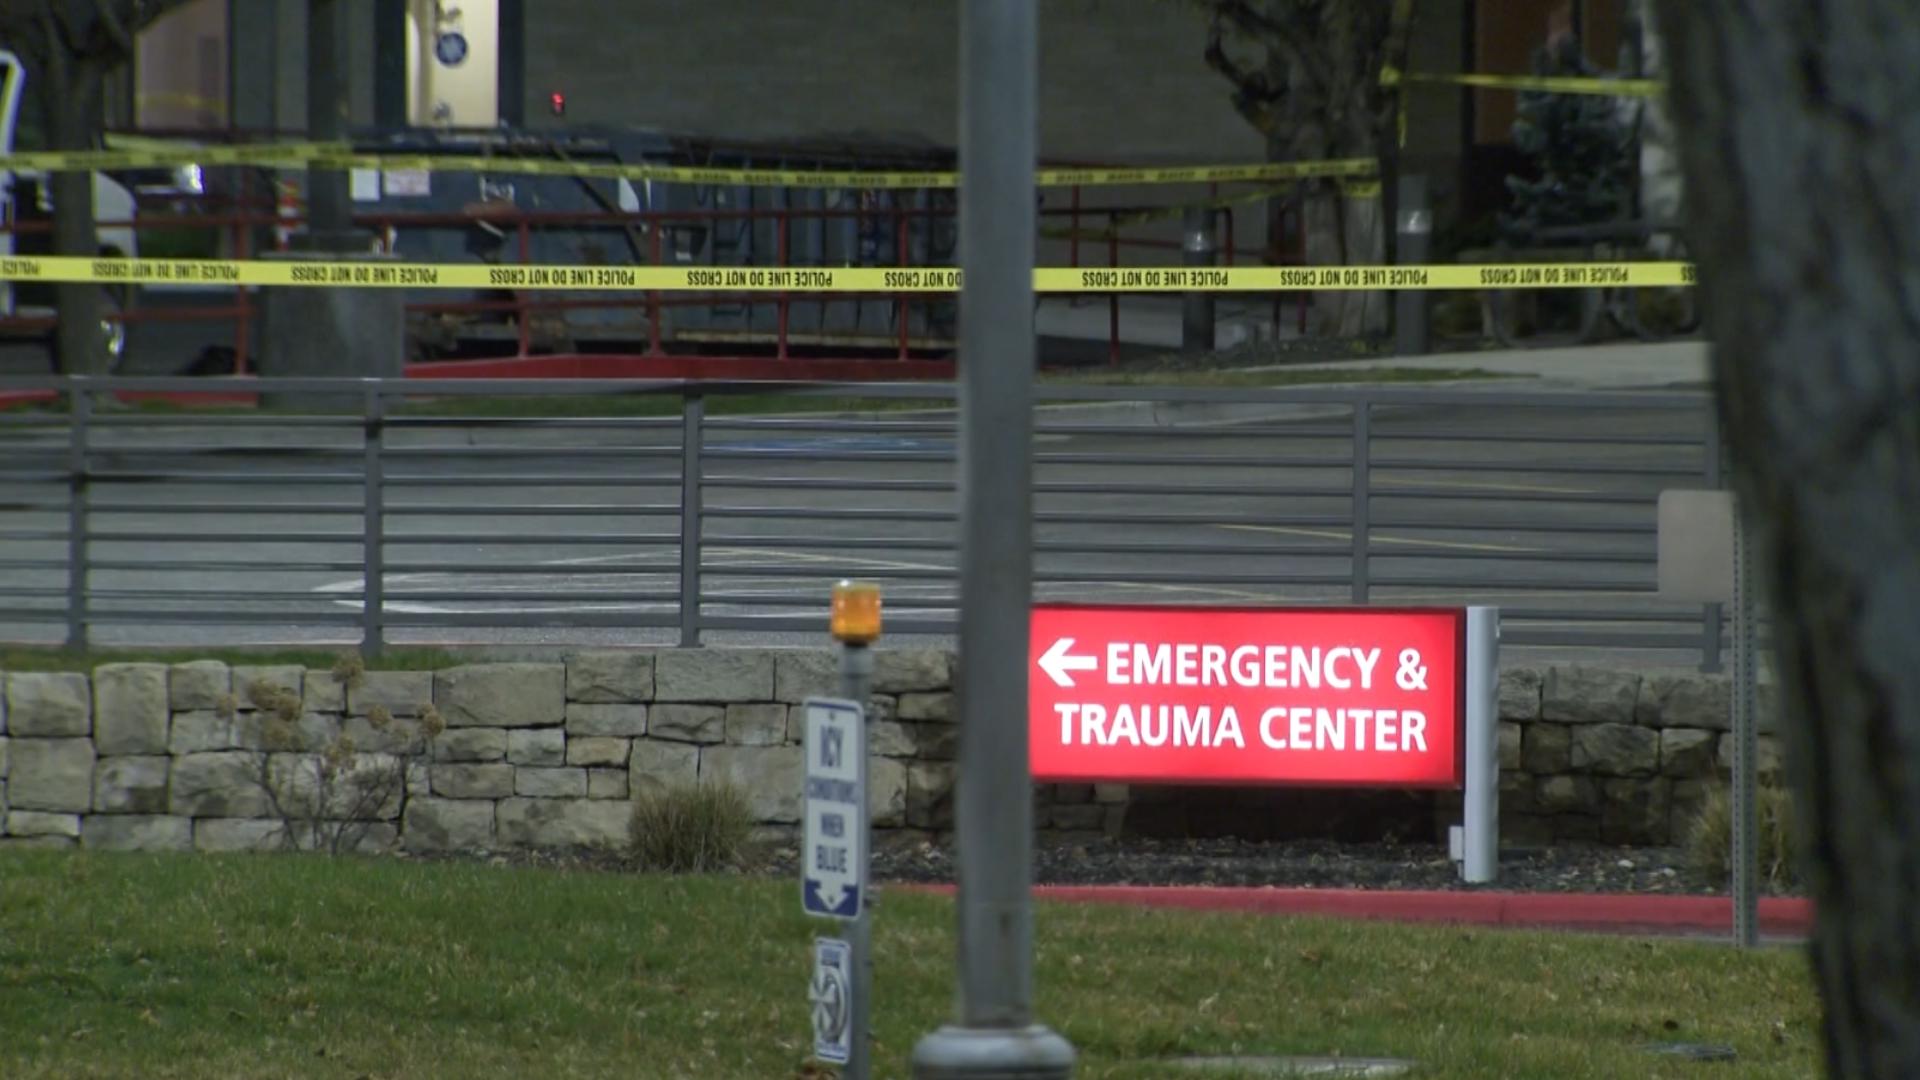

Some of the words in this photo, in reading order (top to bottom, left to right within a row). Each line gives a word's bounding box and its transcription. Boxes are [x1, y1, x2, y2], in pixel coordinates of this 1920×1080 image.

[291, 267, 327, 282] CROSS
[331, 267, 351, 282] NOT
[355, 268, 369, 282] DO
[374, 268, 396, 283] LINE
[400, 268, 437, 283] POLICE
[490, 270, 524, 285] CROSS
[529, 270, 549, 285] NOT
[552, 270, 566, 285] DO
[571, 270, 593, 285] LINE
[598, 270, 634, 285] POLICE
[687, 271, 722, 286] CROSS
[726, 271, 746, 286] NOT
[750, 271, 763, 286] DO
[768, 271, 791, 286] LINE
[795, 271, 832, 286] POLICE
[885, 271, 919, 286] CROSS
[924, 271, 943, 286] NOT
[947, 271, 962, 286] DO
[1082, 271, 1117, 286] CROSS
[1121, 271, 1141, 286] NOT
[1145, 271, 1160, 286] DO
[1164, 271, 1186, 286] LINE
[1191, 271, 1227, 286] POLICE
[1281, 271, 1316, 285] CROSS
[1320, 270, 1340, 285] NOT
[1344, 270, 1358, 285] DO
[1363, 270, 1386, 285] LINE
[1390, 269, 1427, 285] POLICE
[1480, 268, 1516, 284] CROSS
[1520, 268, 1540, 284] NOT
[1544, 267, 1559, 283] DO
[1563, 266, 1586, 282] LINE
[1591, 266, 1628, 282] POLICE
[1106, 642, 1381, 689] EMERGENCY
[1395, 648, 1428, 691] &
[1054, 703, 1246, 749] TRAUMA
[1259, 707, 1428, 752] CENTER
[820, 724, 844, 769] ICY
[821, 813, 845, 838] WHEN
[816, 845, 847, 874] BLUE
